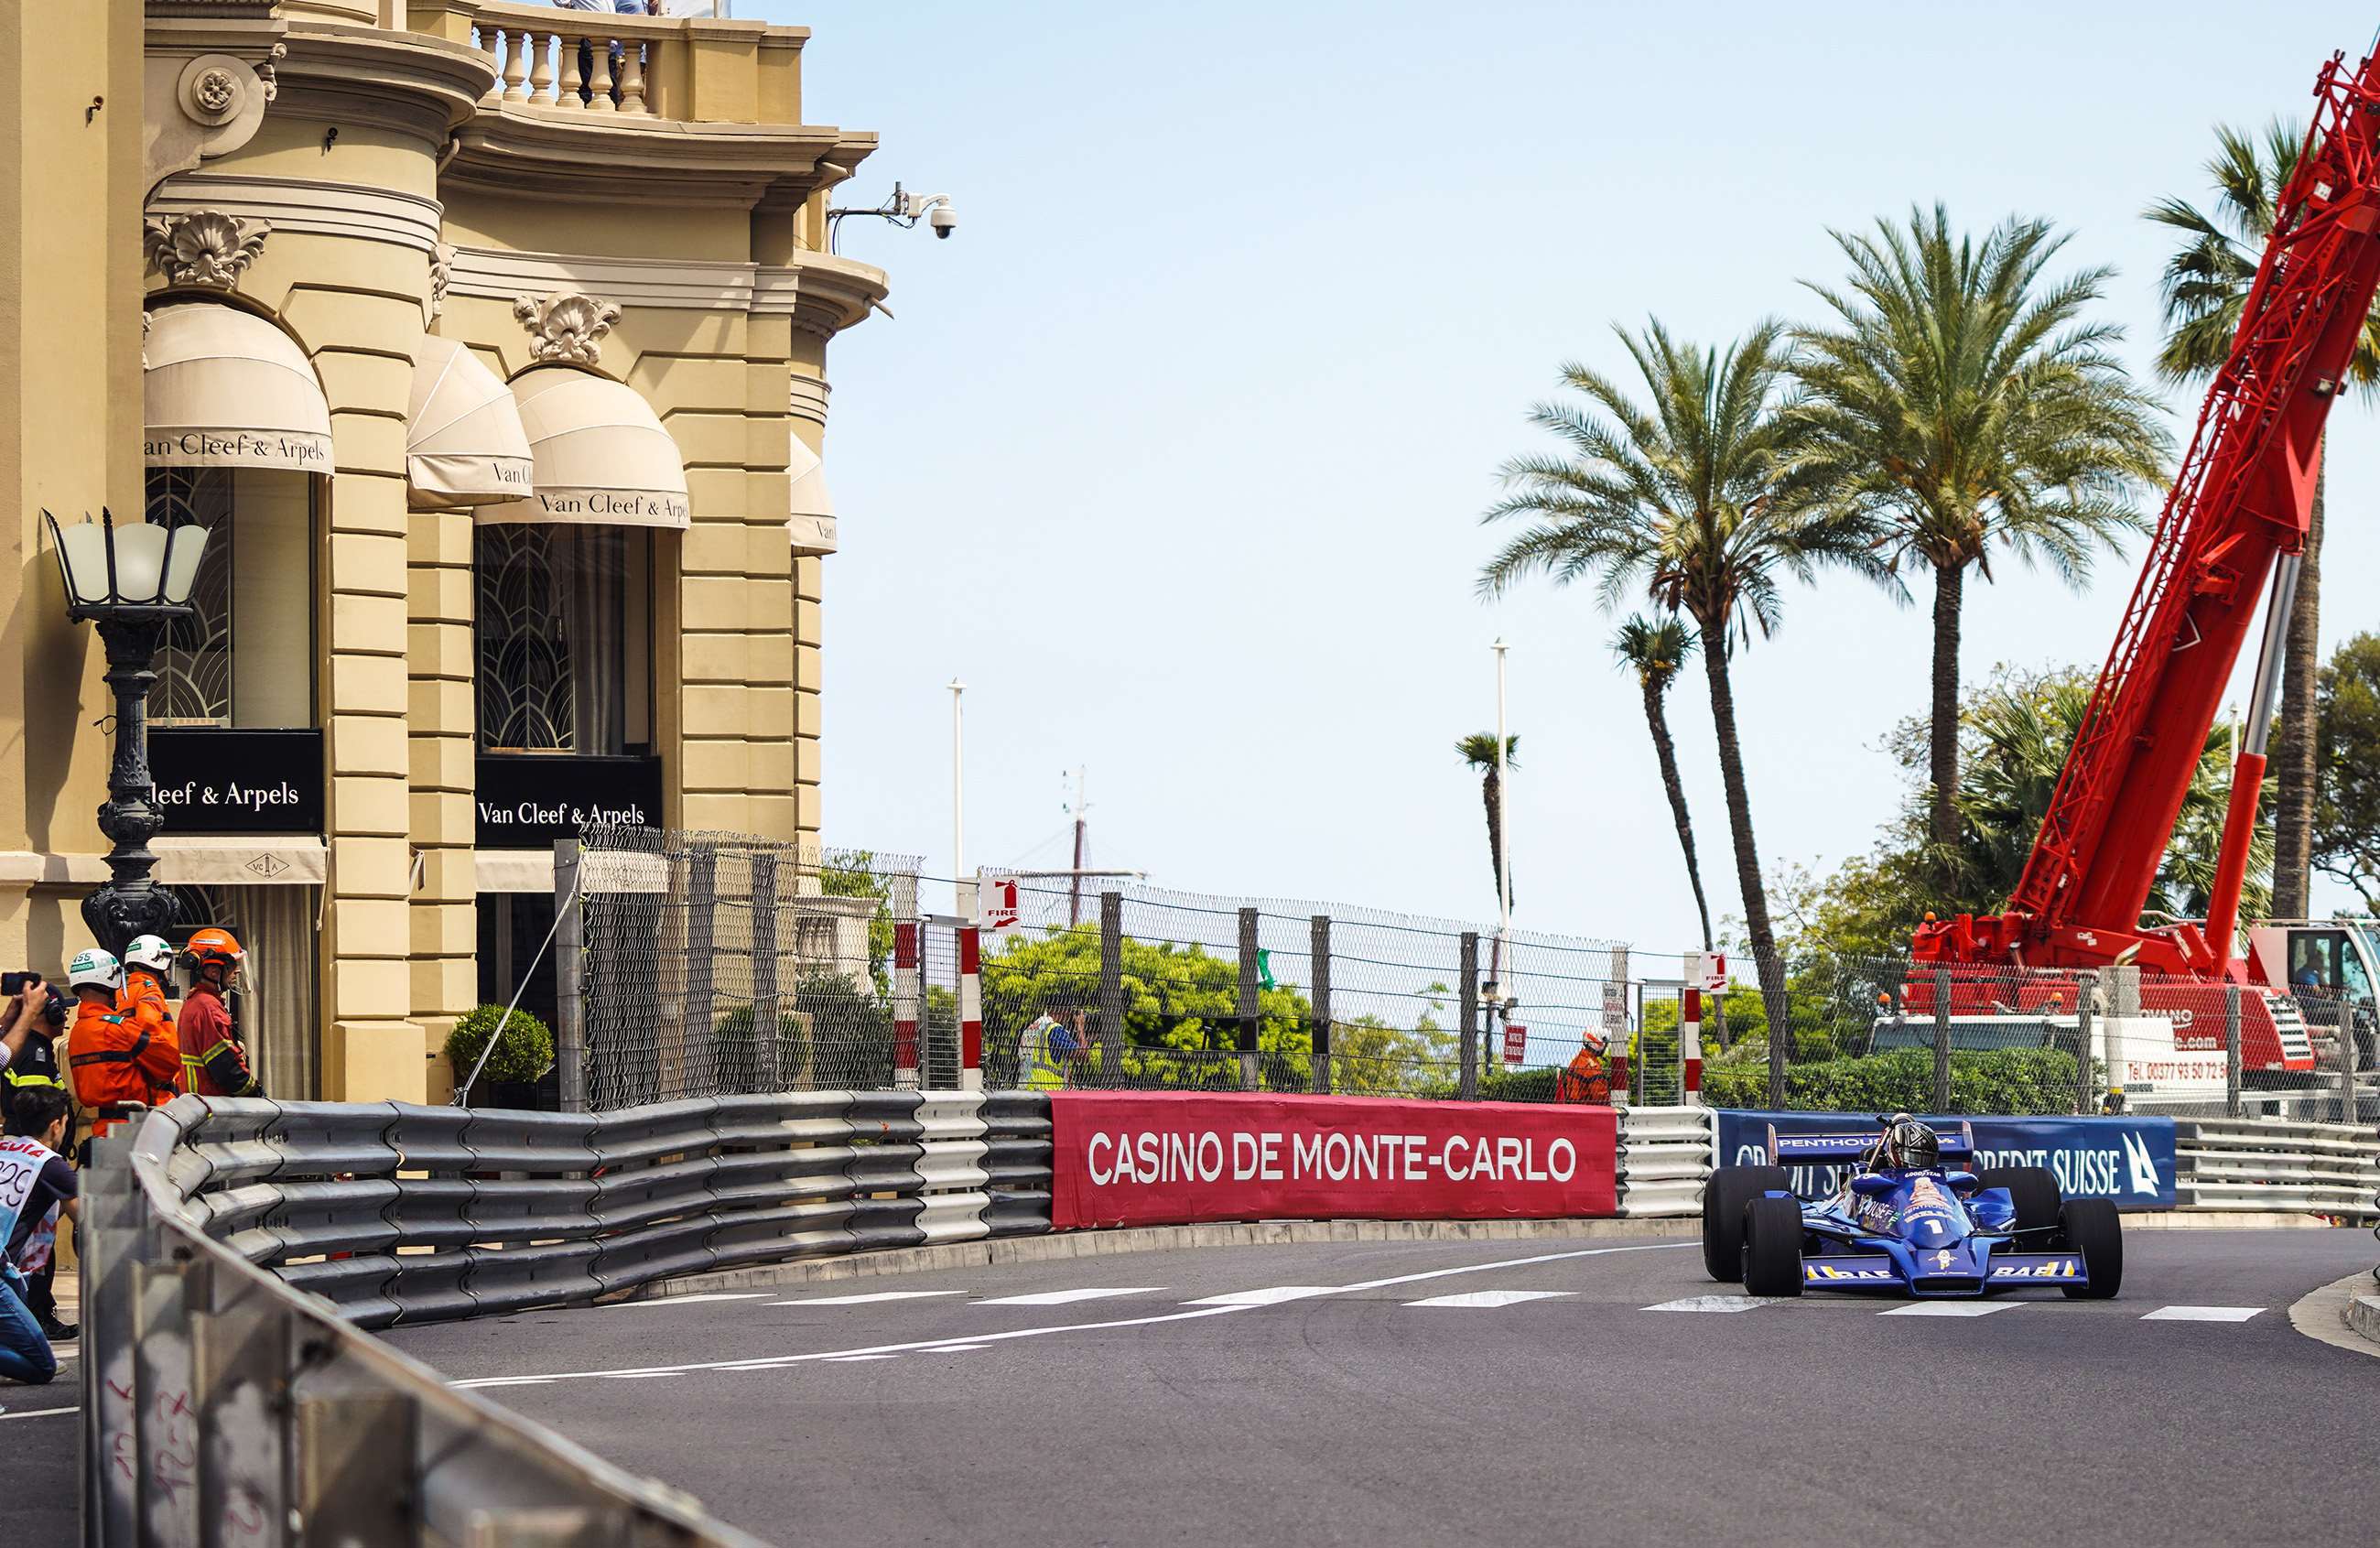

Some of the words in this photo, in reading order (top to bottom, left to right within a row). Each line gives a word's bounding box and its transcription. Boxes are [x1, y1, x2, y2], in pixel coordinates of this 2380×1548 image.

[144, 441, 171, 456] an
[179, 433, 248, 456] Cleef
[254, 439, 268, 457] &
[276, 437, 325, 465] Arpels
[493, 462, 521, 483] Van
[540, 493, 580, 513] Van
[589, 493, 644, 515] Cleef
[648, 501, 659, 515] &
[151, 781, 197, 805] leef
[201, 786, 220, 805] &
[225, 781, 299, 812] Arpels
[479, 802, 514, 824] Van
[518, 802, 568, 825] Cleef
[571, 807, 585, 825] &
[590, 803, 645, 828] Arpels
[1779, 1137, 1881, 1148] PENTHOUS
[1087, 1131, 1224, 1185] CASINO
[1233, 1132, 1284, 1181] DE
[1293, 1132, 1576, 1183] MONTE-CARLO
[2052, 1149, 2122, 1195] SUISSE
[1924, 1219, 1943, 1235] 1
